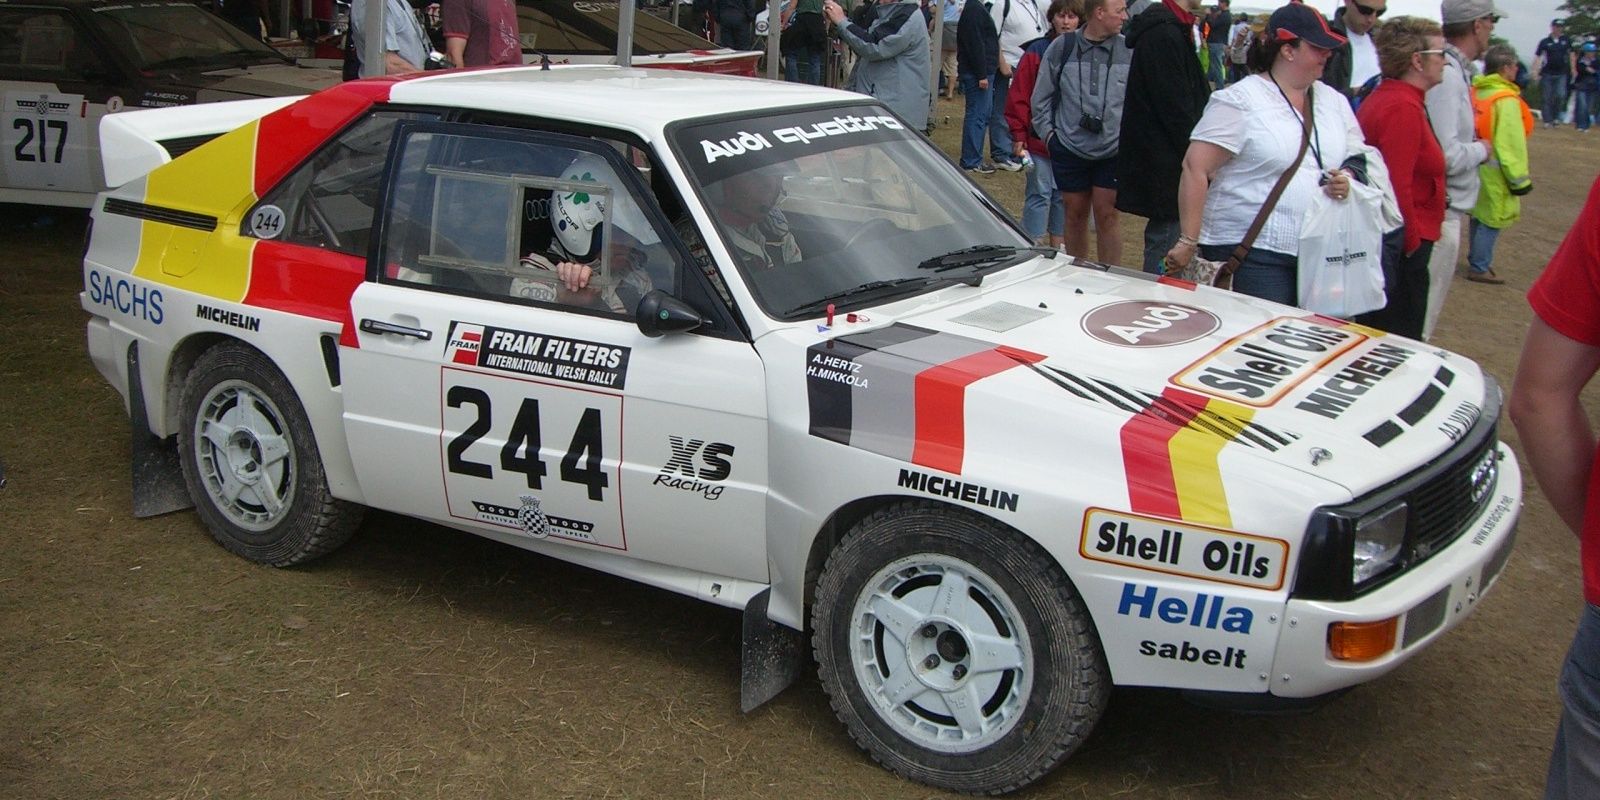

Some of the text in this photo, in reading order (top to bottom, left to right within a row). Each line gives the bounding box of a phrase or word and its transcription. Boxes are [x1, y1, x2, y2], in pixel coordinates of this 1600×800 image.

[13, 117, 68, 163] 217
[700, 115, 904, 163] Audi quattro
[255, 212, 281, 232] 244
[90, 270, 164, 325] SACHS
[196, 304, 260, 332] MICHELIN
[450, 339, 480, 350] FRAM
[1103, 304, 1198, 345] Audi
[486, 353, 618, 387] INTERNATIONAL WELSH RALLY
[488, 330, 623, 369] FRAM FILTERS
[811, 353, 863, 373] A.HERTZ
[1197, 324, 1351, 399] Shell Oils
[806, 365, 868, 389] H.MIKKOLA
[1294, 342, 1416, 420] MICHELIN
[446, 385, 609, 501] 244
[659, 434, 736, 481] XS
[652, 473, 728, 500] Racing
[897, 468, 1020, 513] MICHELIN
[479, 504, 590, 531] GOOD WOOD
[1096, 521, 1270, 579] Shell Oils
[1117, 582, 1255, 635] Hella
[1139, 640, 1247, 670] sabelt
